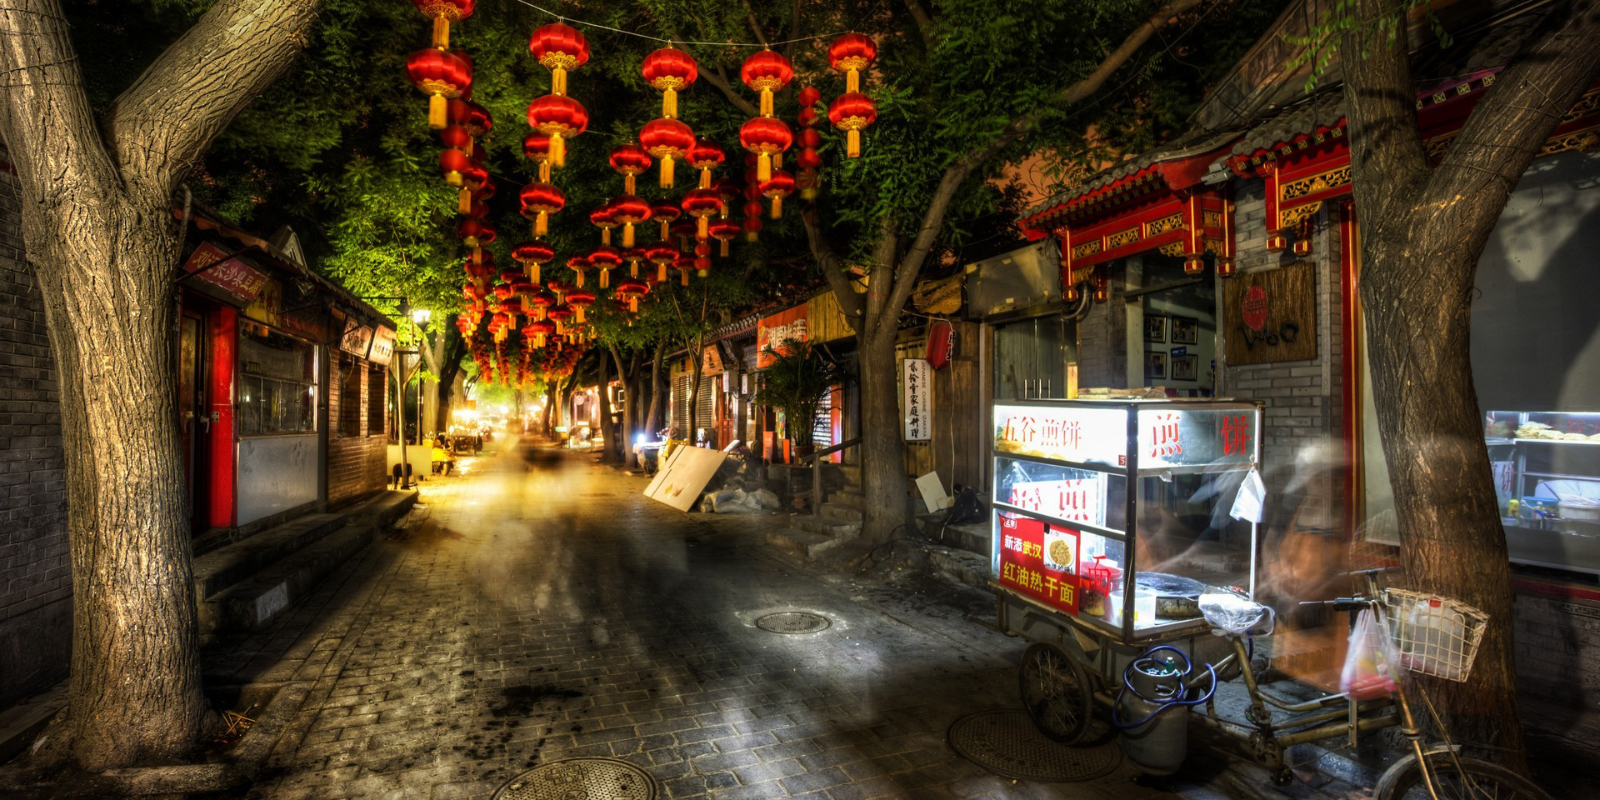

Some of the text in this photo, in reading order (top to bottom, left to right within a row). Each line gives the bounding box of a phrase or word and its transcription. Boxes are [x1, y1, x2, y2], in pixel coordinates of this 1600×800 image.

[1003, 560, 1075, 606] 红油热干面
